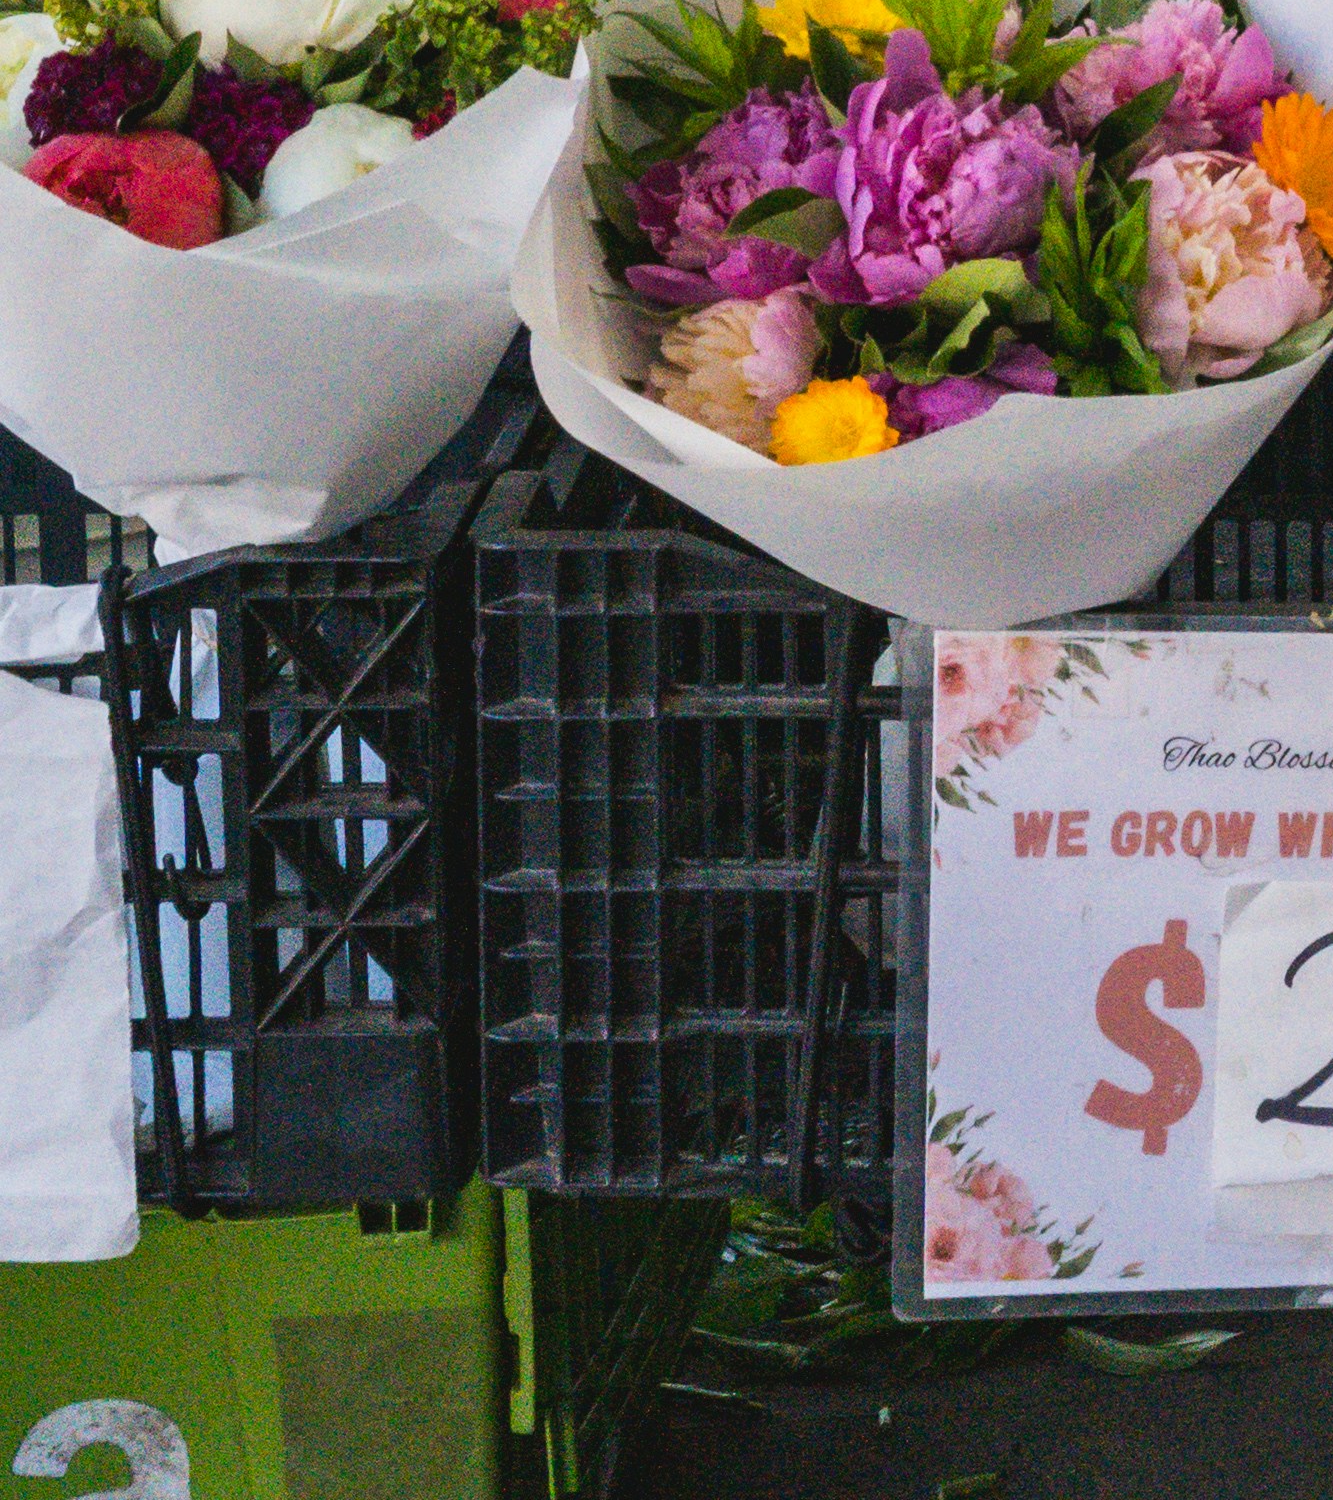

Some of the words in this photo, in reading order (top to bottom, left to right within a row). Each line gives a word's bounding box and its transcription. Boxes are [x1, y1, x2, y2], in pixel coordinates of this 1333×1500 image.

[1162, 735, 1236, 772] Thao
[1012, 810, 1089, 859] WE
[1110, 811, 1255, 859] GROW
